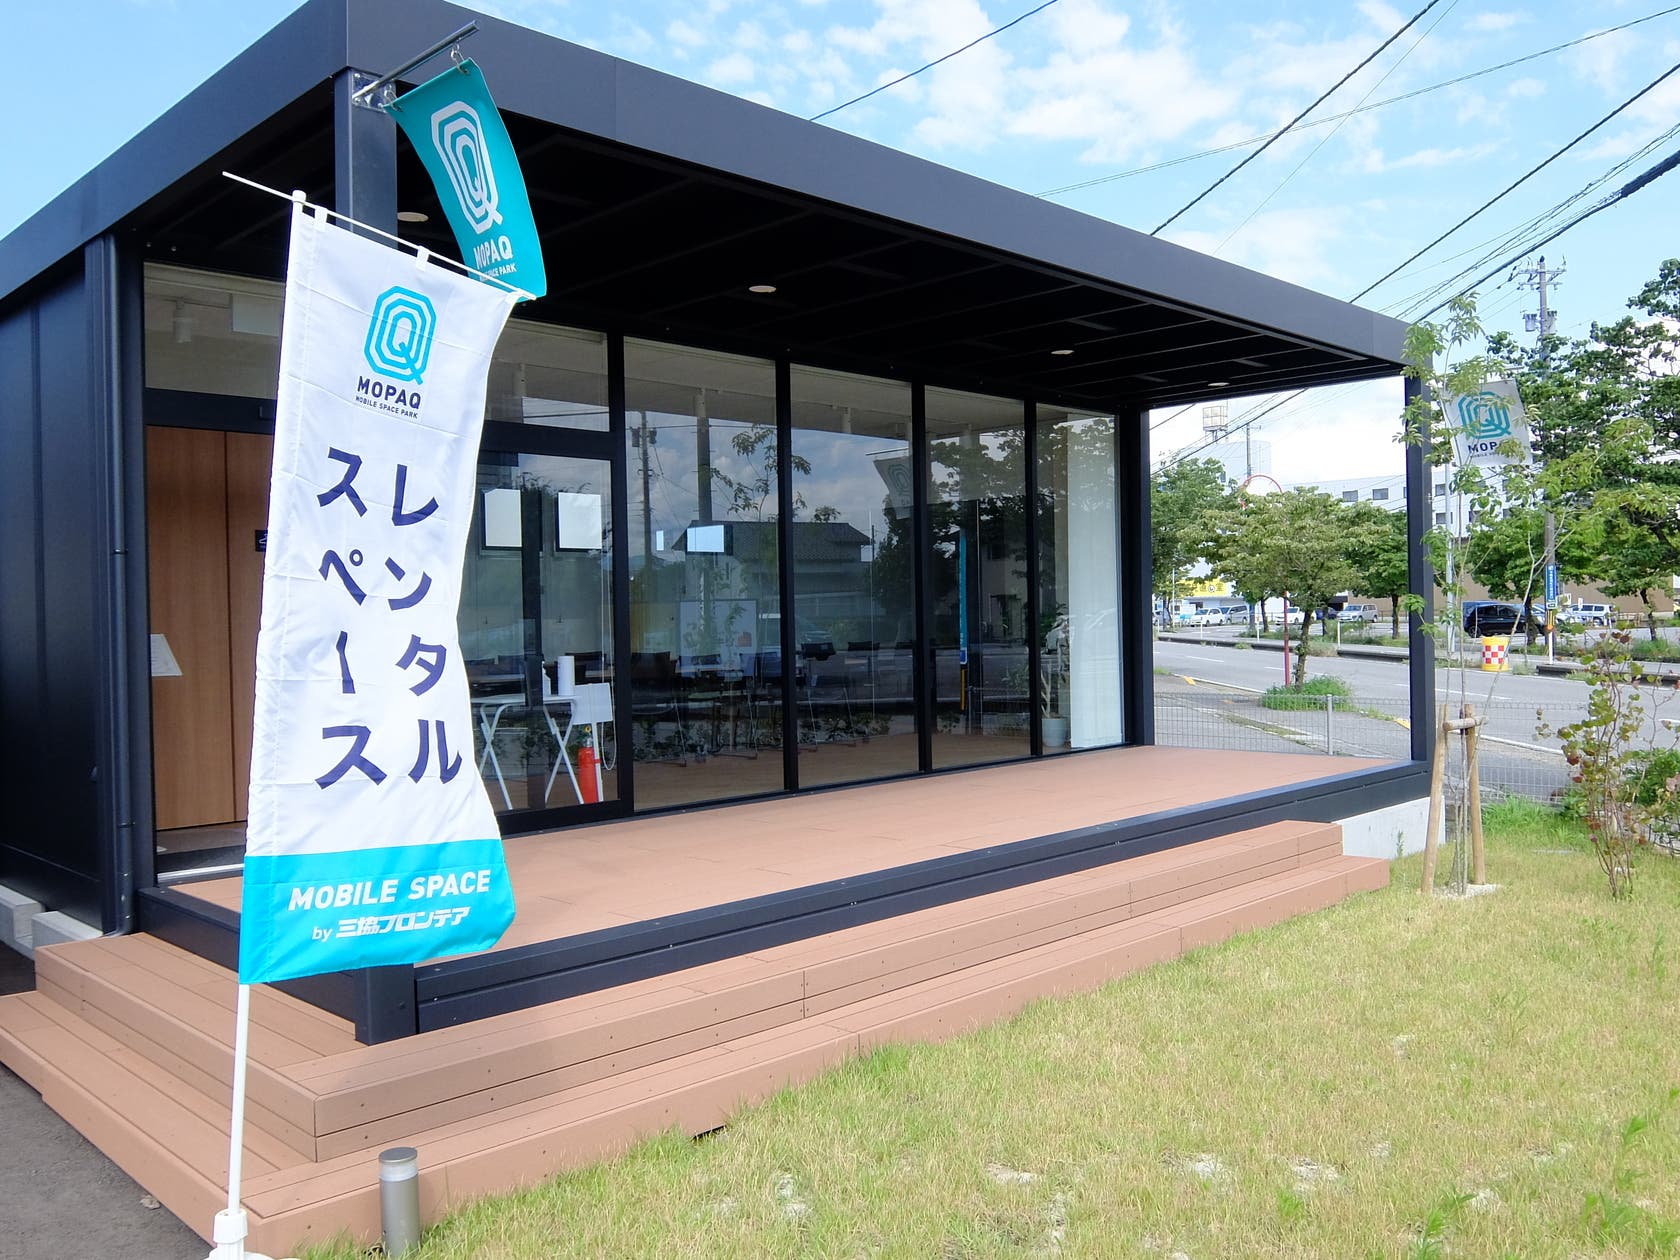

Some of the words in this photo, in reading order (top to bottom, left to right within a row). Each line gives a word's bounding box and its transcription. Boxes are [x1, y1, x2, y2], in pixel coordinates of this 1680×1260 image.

[473, 235, 514, 270] MOPAQ
[499, 263, 517, 276] PARK
[355, 395, 377, 408] MOBILE
[379, 402, 399, 414] SPACE
[400, 408, 418, 419] PARK
[357, 375, 421, 410] MOPAQ
[1467, 441, 1498, 453] MOP
[314, 446, 388, 791] スペース
[385, 463, 463, 785] レンタル
[288, 879, 399, 911] MOBILE
[407, 869, 491, 900] SPACE
[311, 926, 333, 942] by
[335, 906, 471, 939] 三協フロンテア
